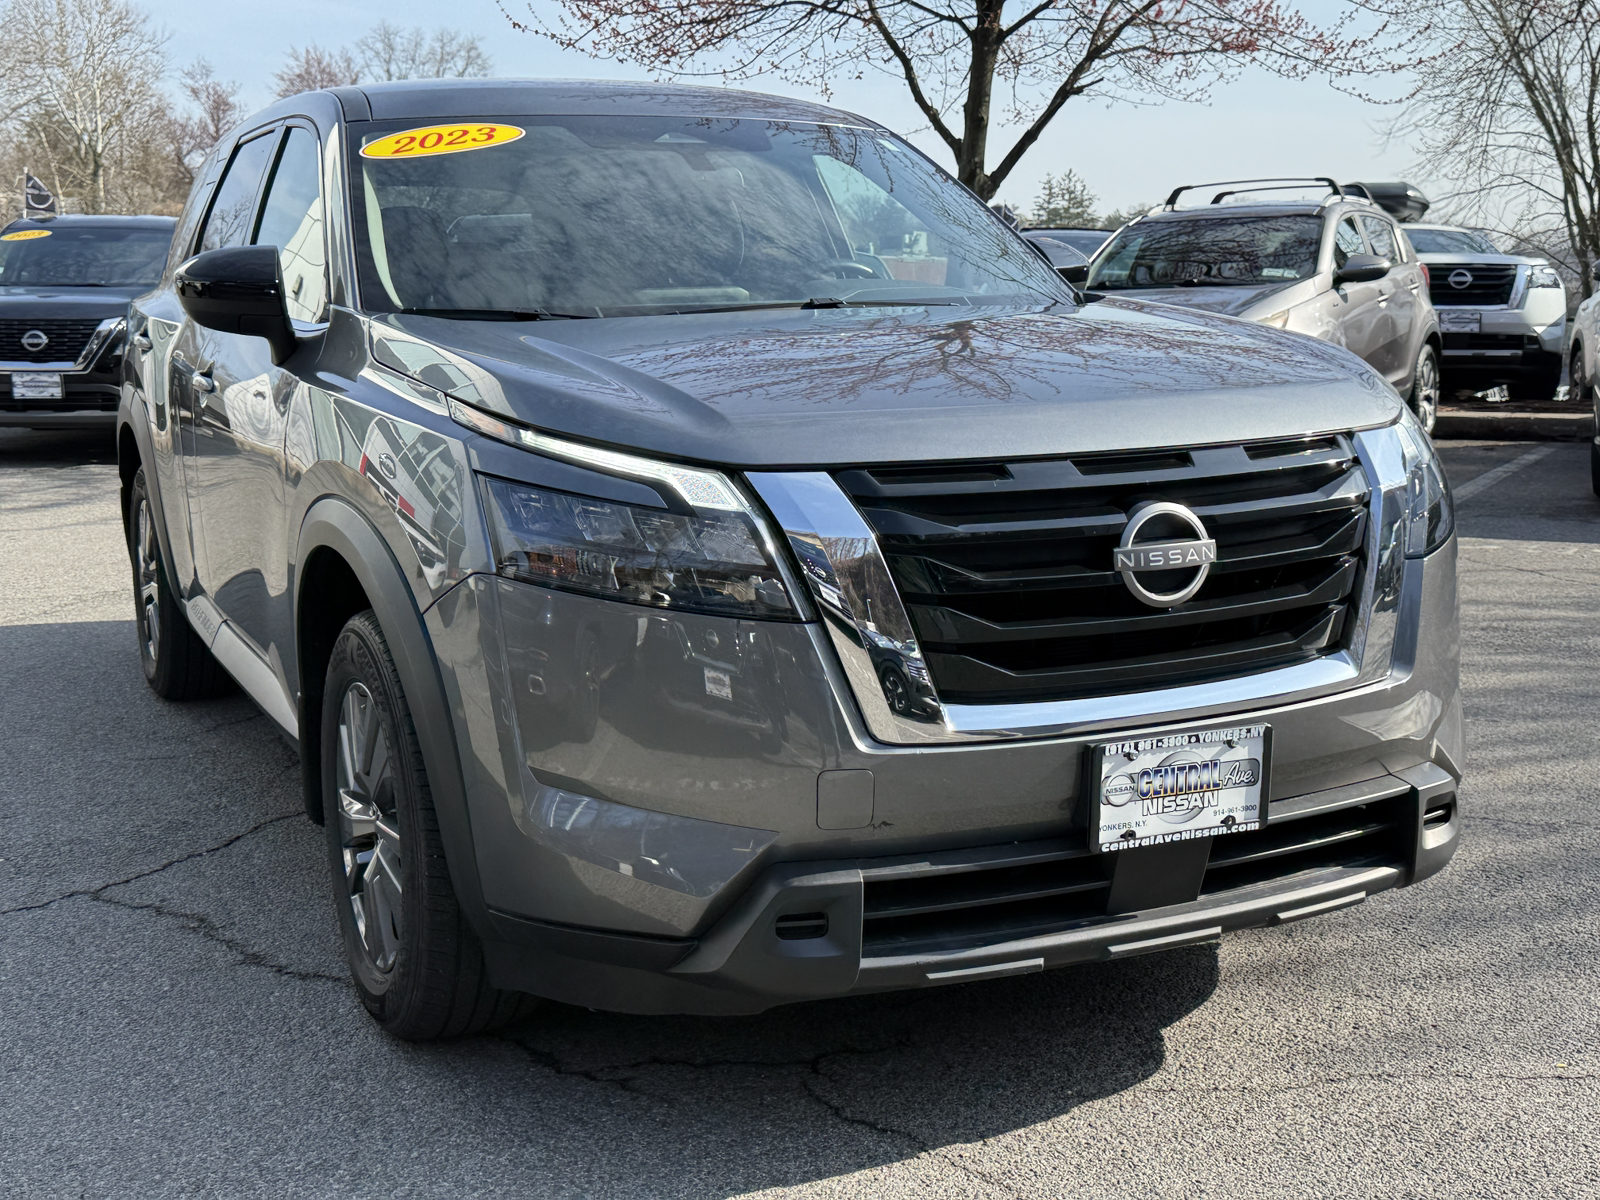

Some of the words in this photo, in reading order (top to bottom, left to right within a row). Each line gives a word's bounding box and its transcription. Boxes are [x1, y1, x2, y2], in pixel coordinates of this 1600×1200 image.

[391, 127, 497, 154] 2023
[1117, 544, 1214, 567] NISSAN
[1138, 735, 1189, 750] 961-3900
[1105, 785, 1135, 794] NISSAN
[1137, 759, 1223, 799] CENTRAL
[1223, 761, 1255, 786] Ave.
[1142, 790, 1219, 816] NISSAN
[1213, 804, 1257, 816] 914-961-3900
